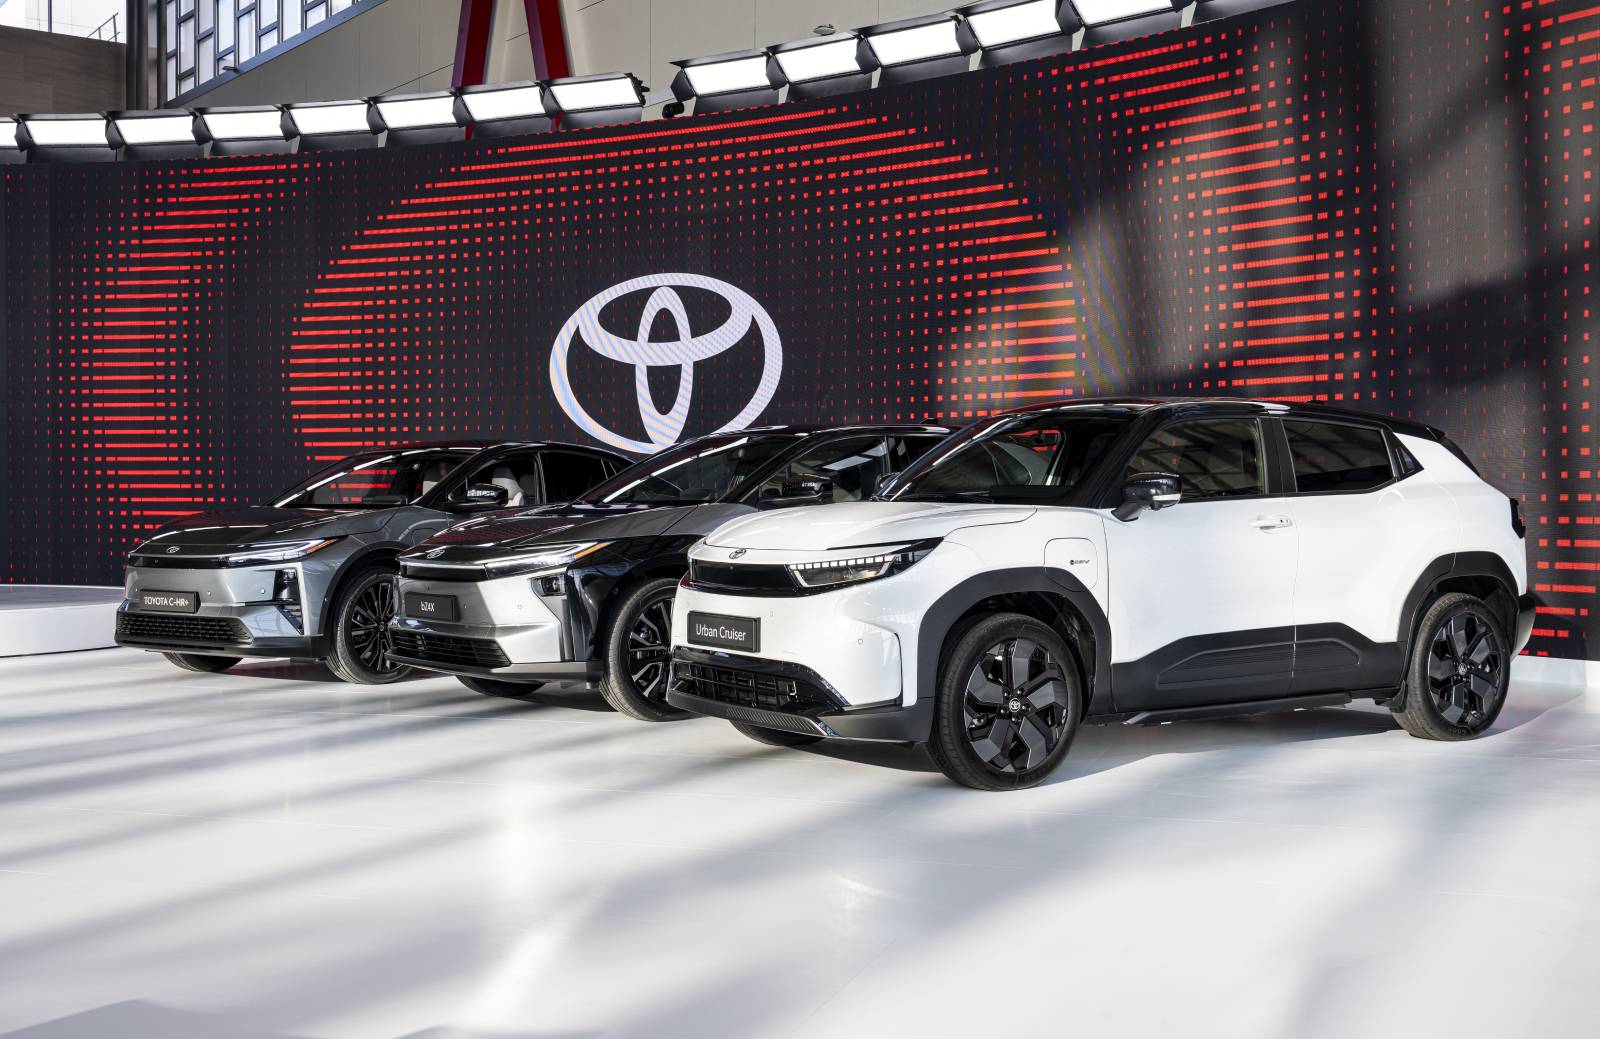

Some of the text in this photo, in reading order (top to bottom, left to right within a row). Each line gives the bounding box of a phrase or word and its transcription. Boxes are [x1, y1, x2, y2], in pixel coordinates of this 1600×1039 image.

[144, 596, 189, 607] TOYOTA C-HR+
[420, 600, 435, 612] bZ4X
[695, 623, 746, 641] Urban Cruiser
